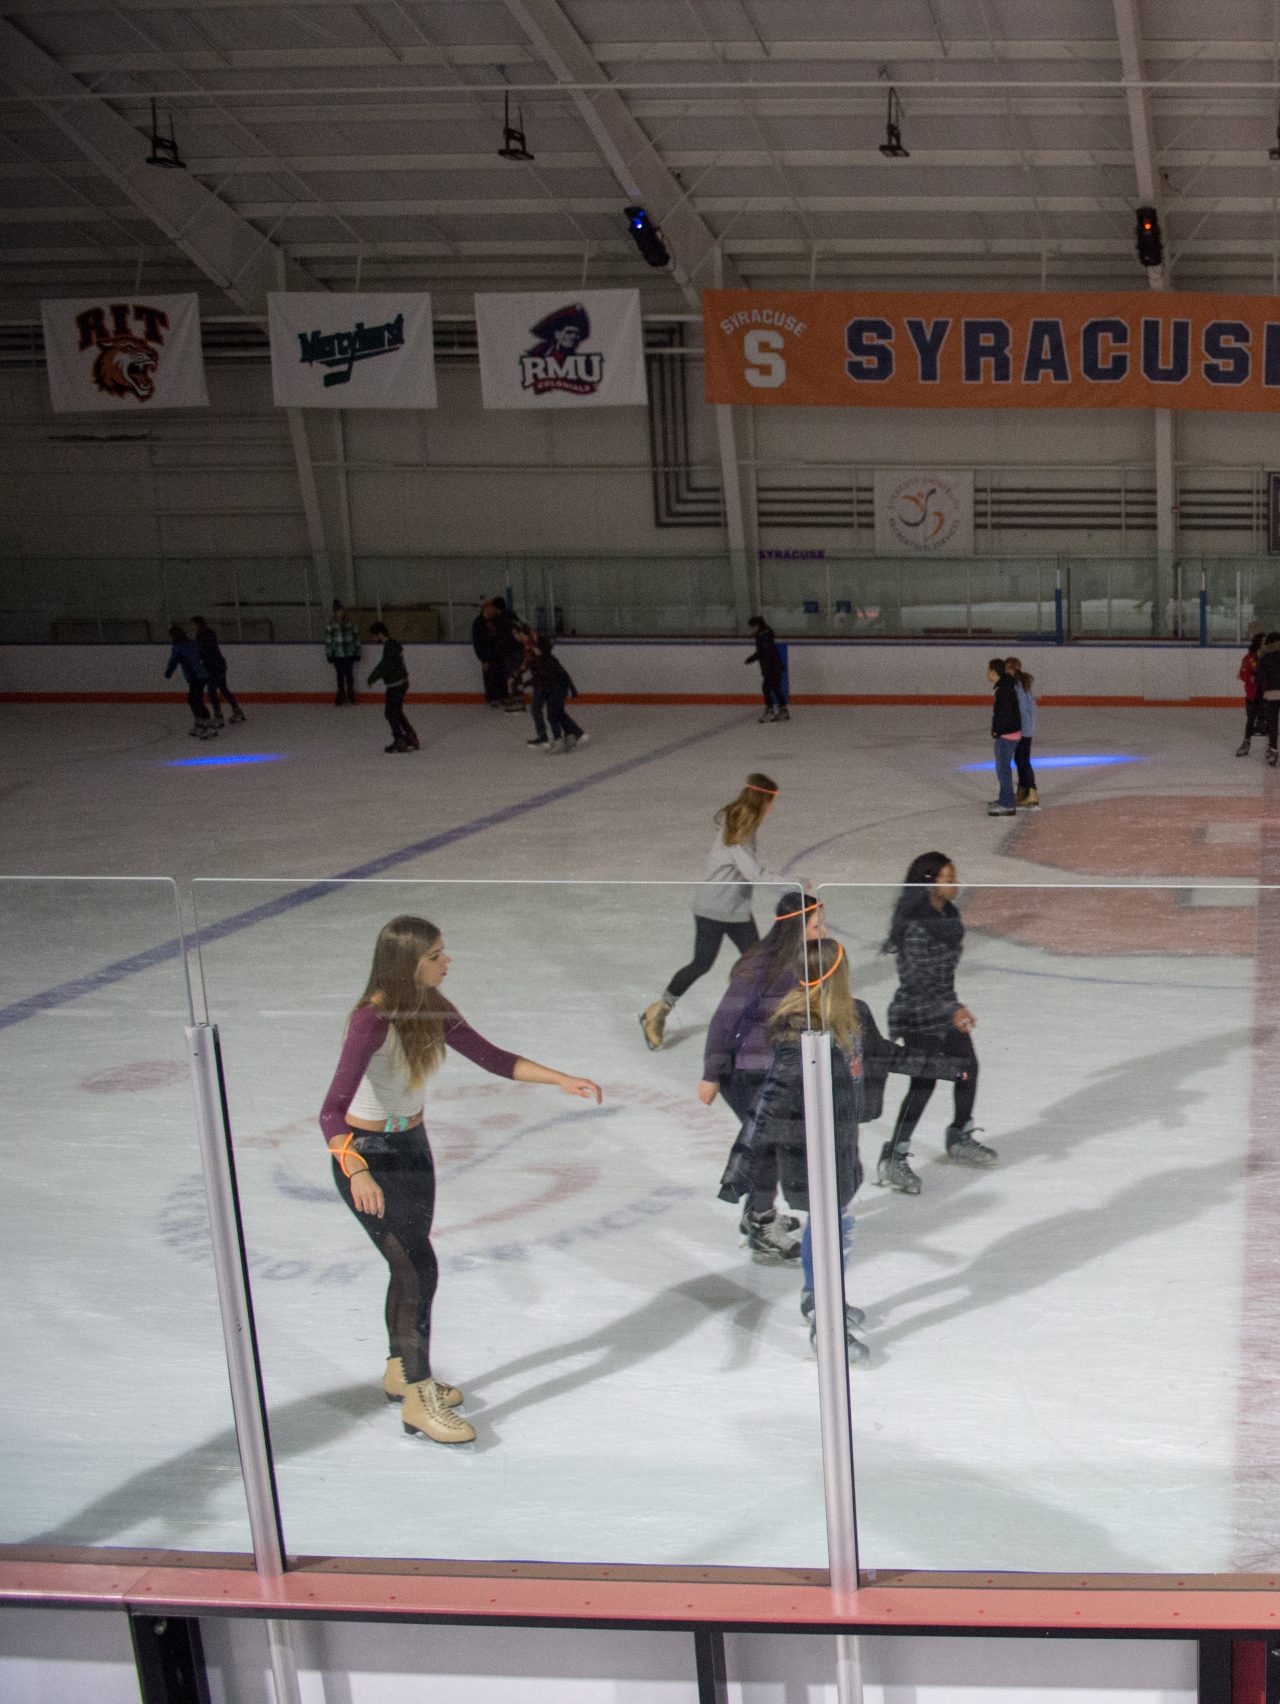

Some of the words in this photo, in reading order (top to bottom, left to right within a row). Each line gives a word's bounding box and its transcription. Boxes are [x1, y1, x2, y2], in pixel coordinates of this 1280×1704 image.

[76, 304, 170, 351] RIT
[720, 309, 807, 337] SYRACUSE
[520, 353, 604, 389] RMU
[744, 329, 786, 389] S
[757, 549, 826, 560] SYRACUSE
